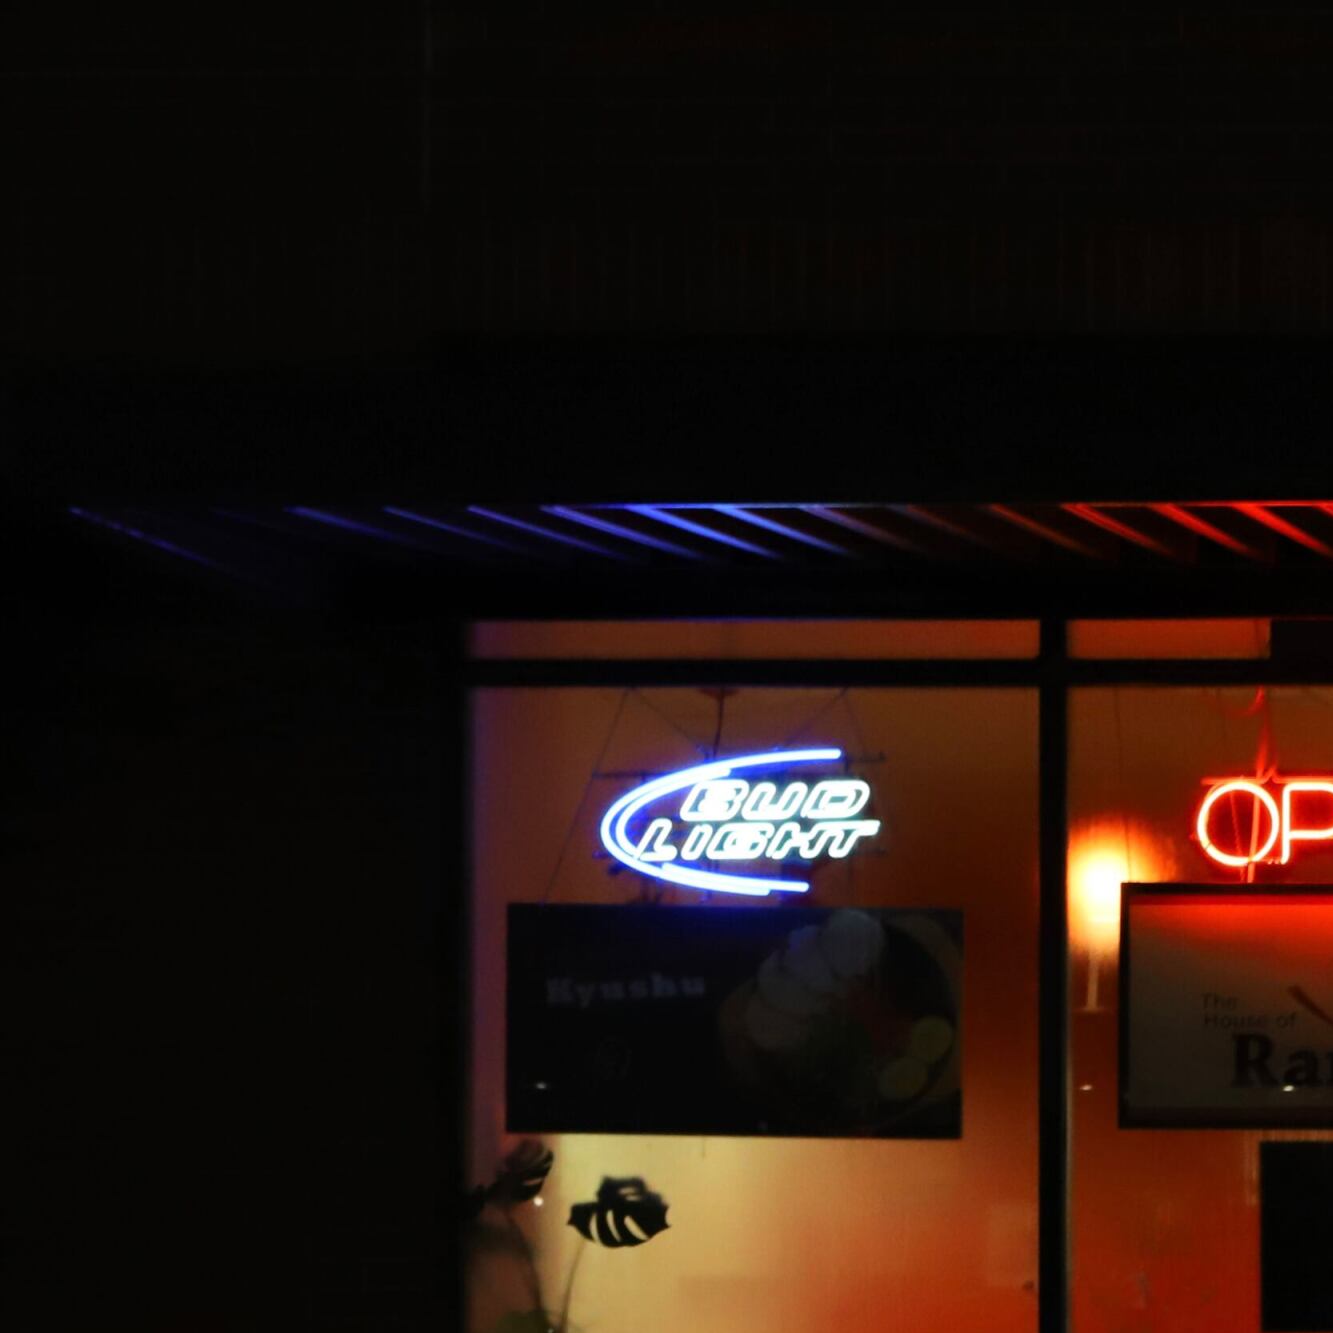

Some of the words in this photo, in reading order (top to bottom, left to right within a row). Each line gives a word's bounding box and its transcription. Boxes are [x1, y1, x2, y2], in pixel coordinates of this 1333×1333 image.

[679, 779, 871, 822] BUD
[637, 818, 882, 862] LIGHT
[544, 971, 707, 1009] Kyushu
[1204, 1012, 1268, 1029] House
